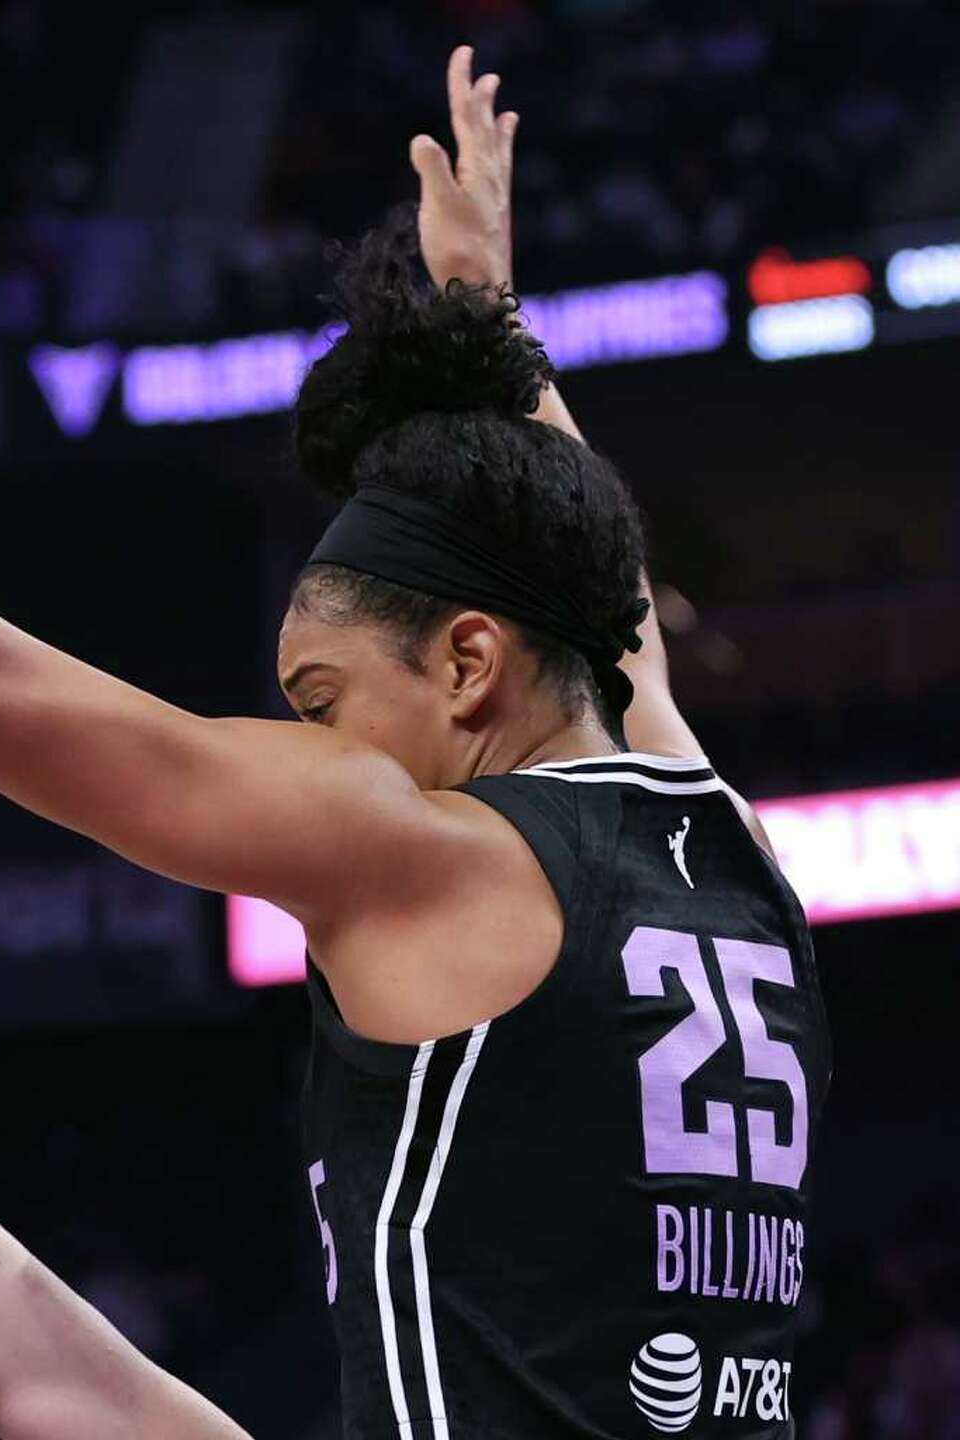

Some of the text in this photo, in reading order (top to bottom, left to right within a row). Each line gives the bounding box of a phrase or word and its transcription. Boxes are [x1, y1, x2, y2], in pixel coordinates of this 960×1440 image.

[621, 925, 809, 1190] 25
[656, 1203, 804, 1307] BILLINGS
[713, 1356, 792, 1421] AT&T
